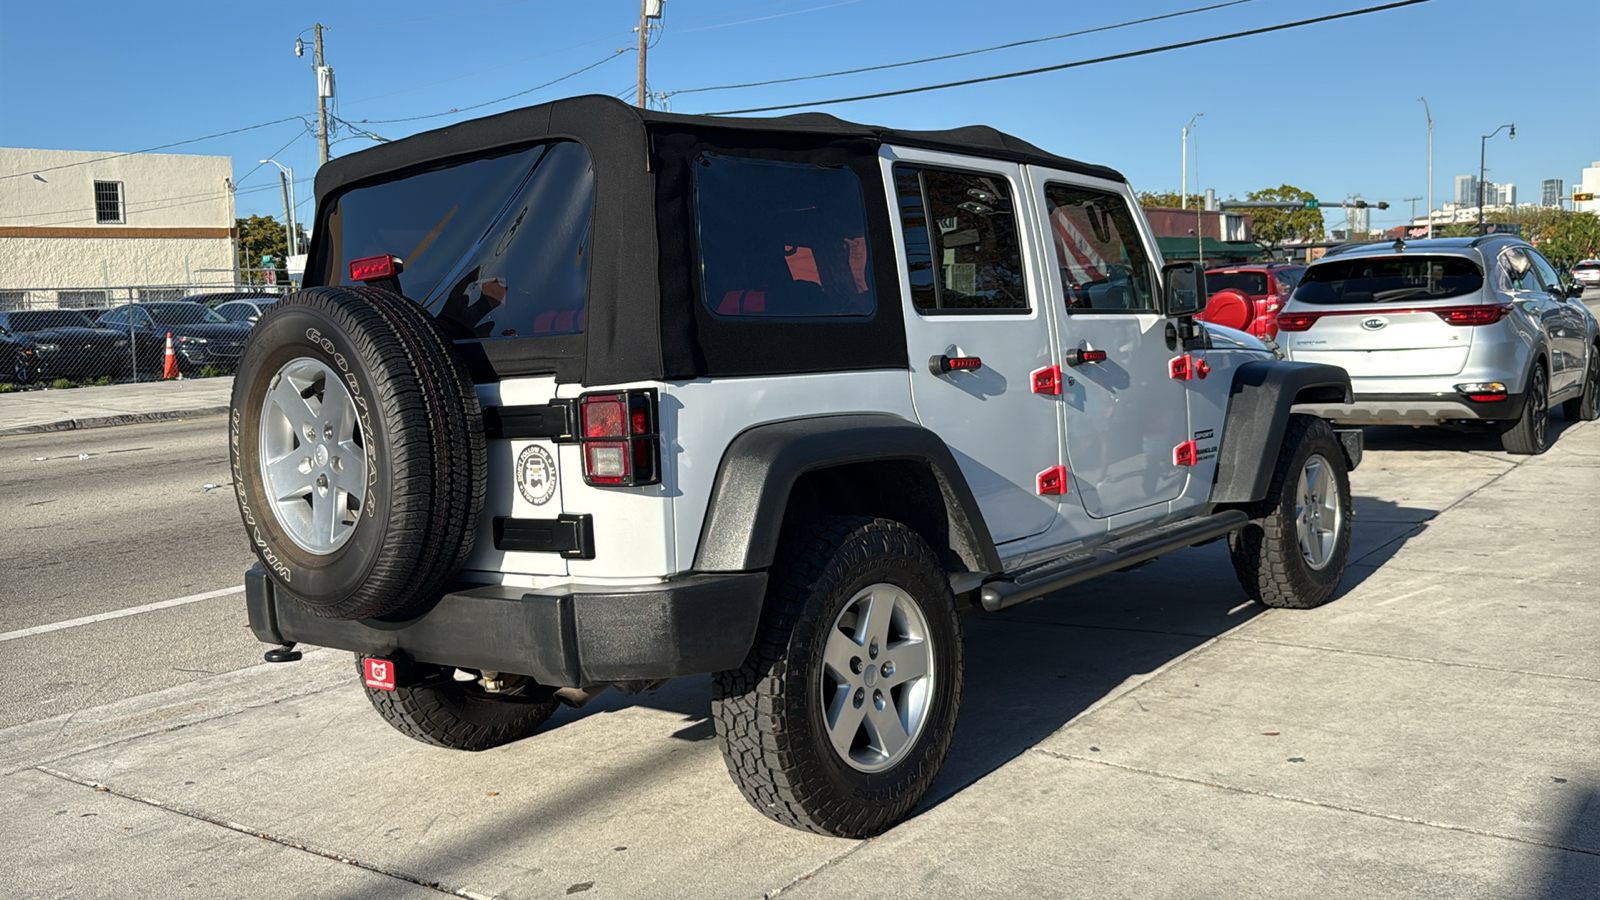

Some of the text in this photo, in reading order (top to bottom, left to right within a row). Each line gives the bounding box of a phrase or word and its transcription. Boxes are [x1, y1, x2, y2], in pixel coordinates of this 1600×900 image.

[305, 327, 378, 518] GOODYEAR
[1195, 431, 1213, 439] SPORT
[521, 446, 540, 460] FOLLOW
[540, 449, 548, 458] ME
[1196, 446, 1217, 454] RANGLER
[231, 407, 292, 583] WRANGLER
